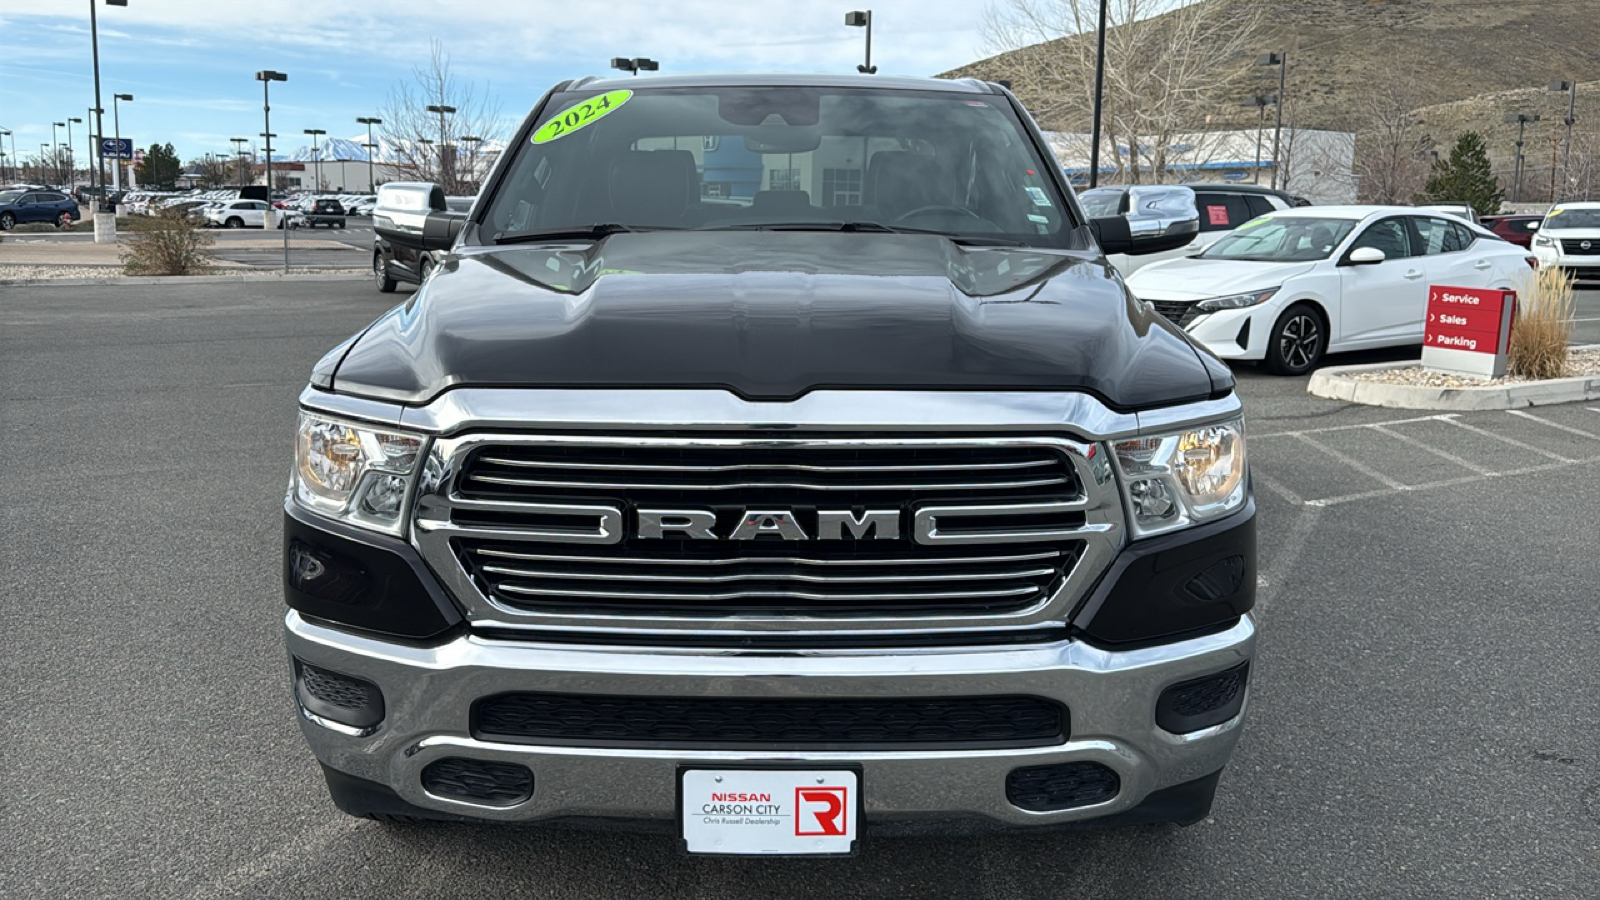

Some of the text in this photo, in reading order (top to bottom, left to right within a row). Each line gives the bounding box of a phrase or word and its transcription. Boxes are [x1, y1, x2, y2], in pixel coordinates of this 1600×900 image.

[548, 95, 611, 137] 2024
[1442, 293, 1480, 305] Service
[1439, 314, 1467, 325] Sales
[1437, 334, 1477, 350] Parking
[636, 509, 900, 540] RAM
[711, 793, 771, 802] NISSAN
[702, 804, 781, 815] CARSON CITY
[703, 816, 781, 826] Chris Russell Dealership
